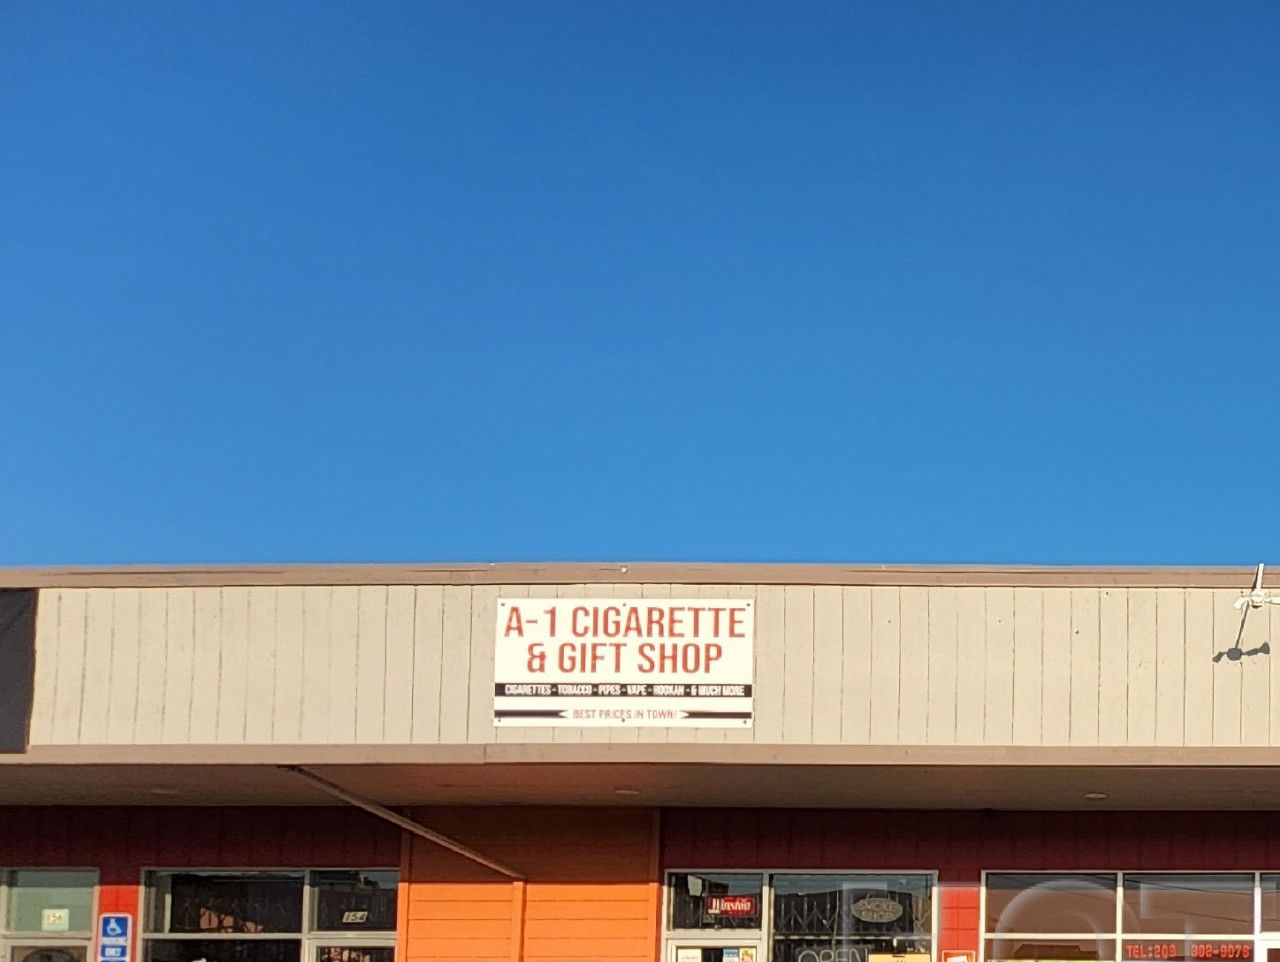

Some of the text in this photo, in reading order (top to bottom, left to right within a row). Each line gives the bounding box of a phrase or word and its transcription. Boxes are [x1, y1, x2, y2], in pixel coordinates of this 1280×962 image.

[504, 606, 746, 638] A-1 CIGARETTE
[527, 642, 723, 673] & GIFT SHOP
[505, 684, 552, 696] CIGARETTES
[558, 685, 592, 696] TOBACCO
[599, 685, 621, 696] PIPES
[627, 685, 648, 696] VAPE
[723, 686, 745, 696] MORE
[573, 709, 597, 719] BEST
[599, 709, 632, 719] PRICES
[634, 710, 644, 719] IN
